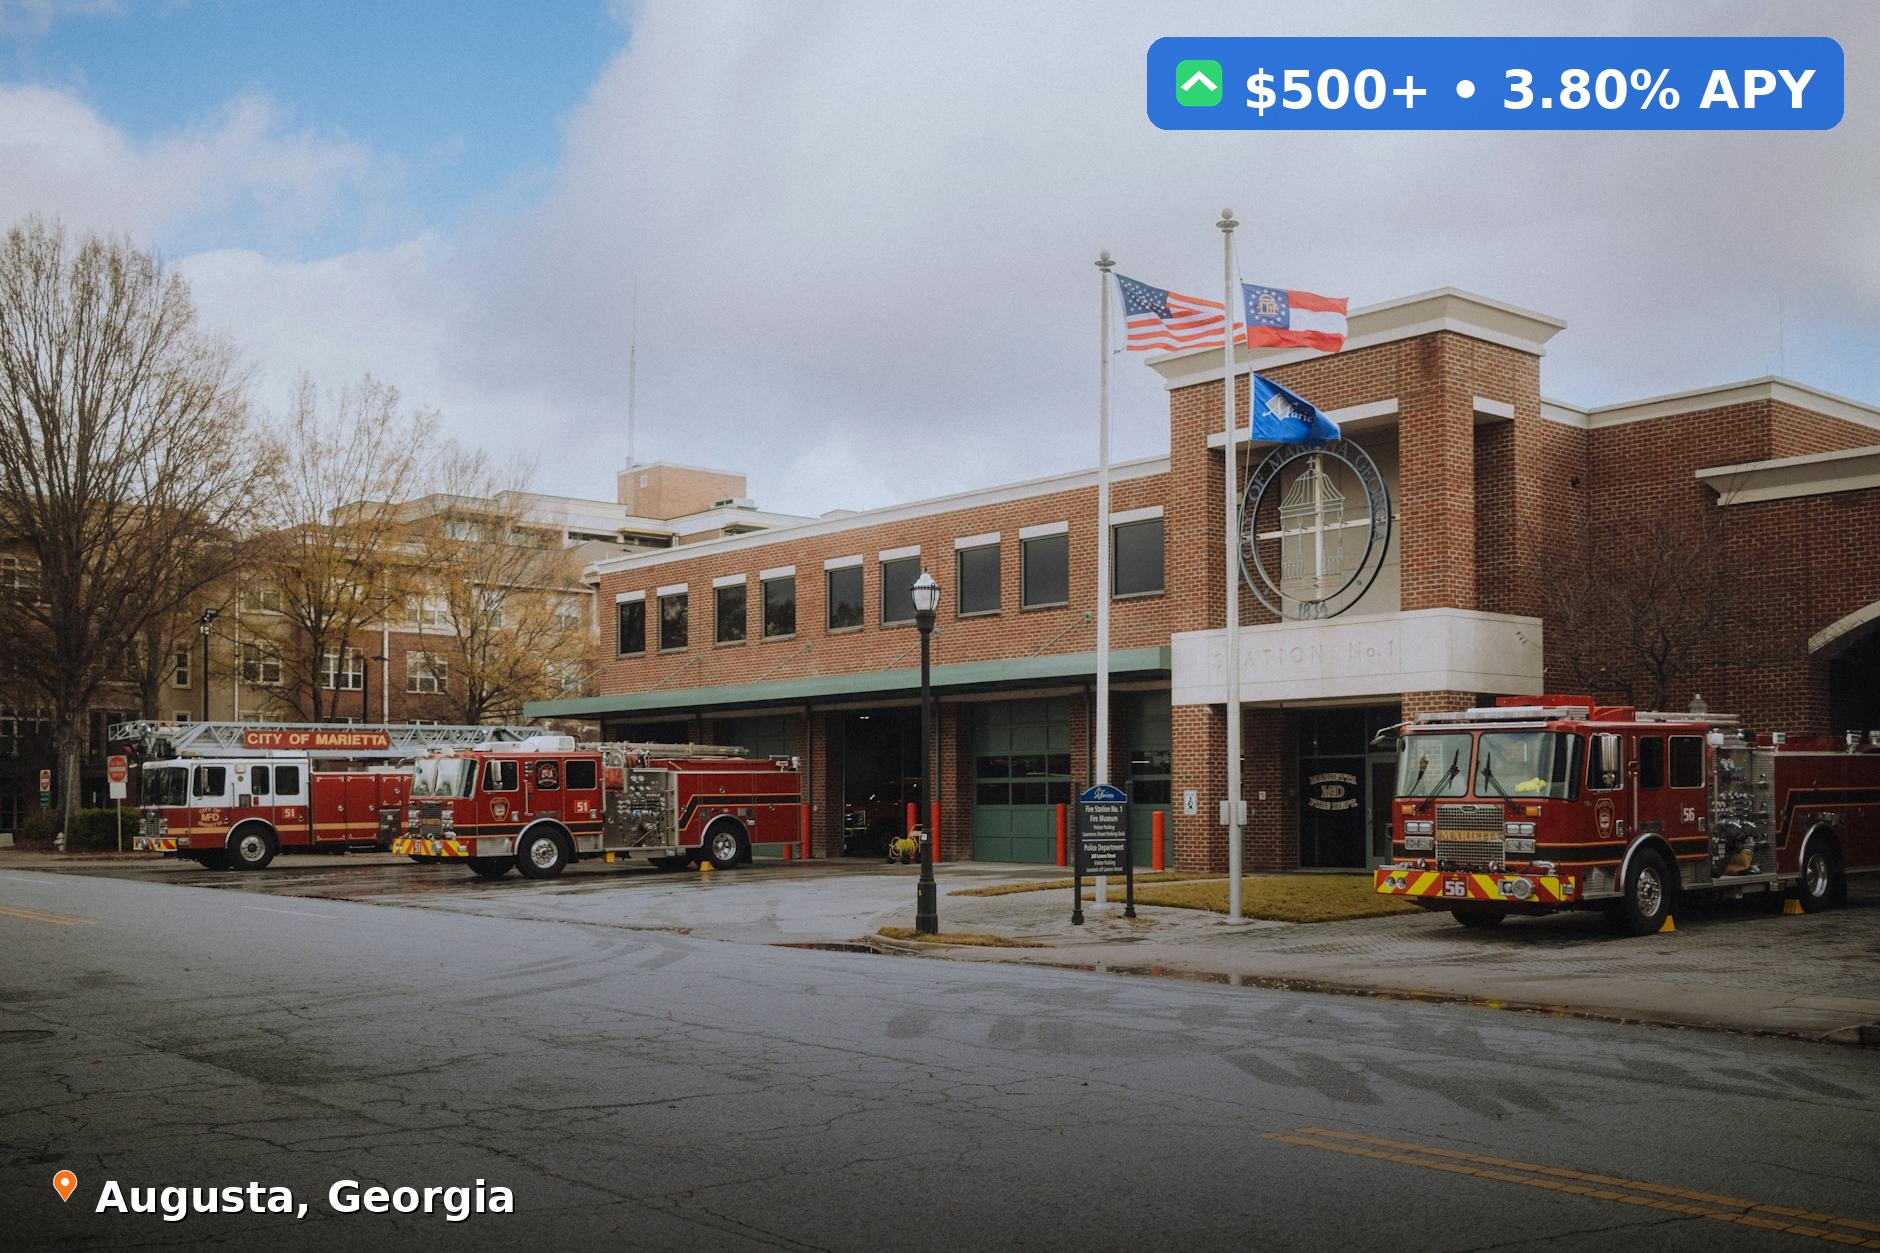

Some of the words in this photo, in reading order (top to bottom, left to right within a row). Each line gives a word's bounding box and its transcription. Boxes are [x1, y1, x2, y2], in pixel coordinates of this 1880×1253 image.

[1249, 473, 1265, 501] OF
[1213, 644, 1323, 670] SATION
[247, 733, 282, 745] CITY
[289, 733, 310, 745] OF
[315, 734, 388, 746] MARIETTA
[284, 808, 296, 818] 51
[577, 801, 588, 812] 51
[1085, 805, 1094, 813] Fire
[1094, 805, 1111, 813] Station
[1683, 807, 1696, 822] 56
[1097, 844, 1124, 852] Department
[1444, 880, 1466, 897] 56
